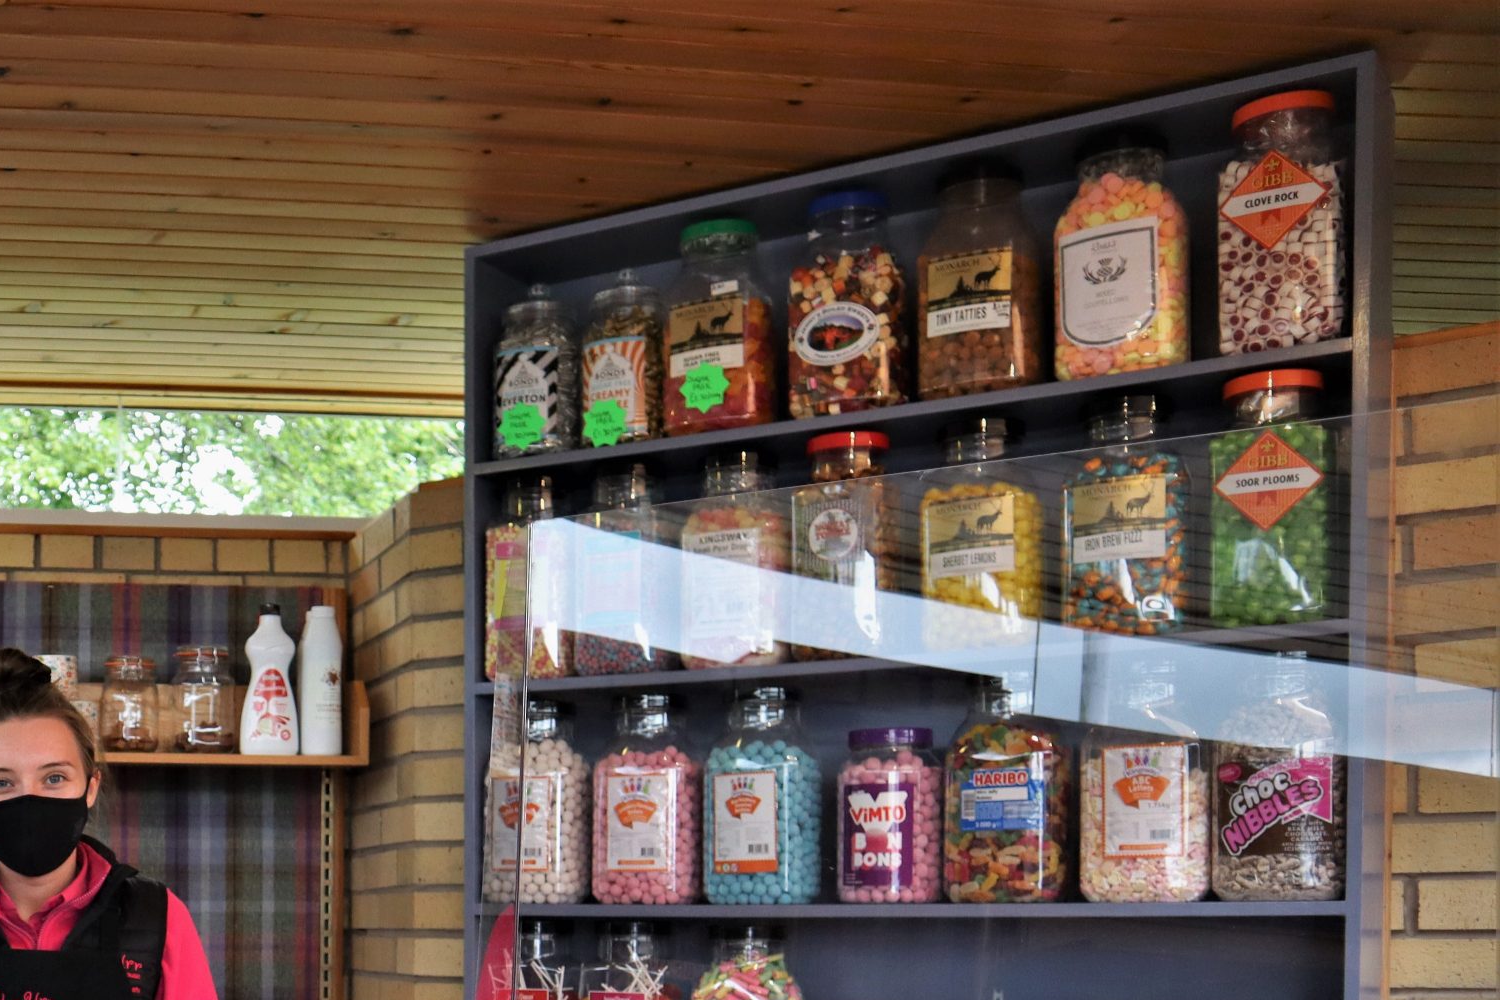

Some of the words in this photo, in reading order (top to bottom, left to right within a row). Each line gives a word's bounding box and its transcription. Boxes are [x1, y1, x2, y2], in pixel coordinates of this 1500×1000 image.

[1251, 171, 1295, 189] GIBB
[1245, 196, 1273, 210] CLOVE
[1275, 191, 1299, 204] ROCK
[936, 311, 951, 327] TINY
[955, 306, 987, 322] TATTIES
[1248, 453, 1288, 469] GIBB
[1235, 476, 1260, 488] SOOR
[1262, 473, 1300, 486] PLOOMS
[1081, 483, 1131, 497] MONARCH
[1084, 537, 1100, 552] IRON
[1102, 533, 1122, 548] BREW
[943, 553, 968, 568] SHERBET
[970, 552, 997, 565] LEMONS
[974, 771, 1028, 787] HARIBO
[1132, 774, 1151, 784] ABC
[1128, 785, 1154, 793] Letters
[1223, 778, 1321, 853] NIBBLES
[853, 852, 902, 868] BONS
